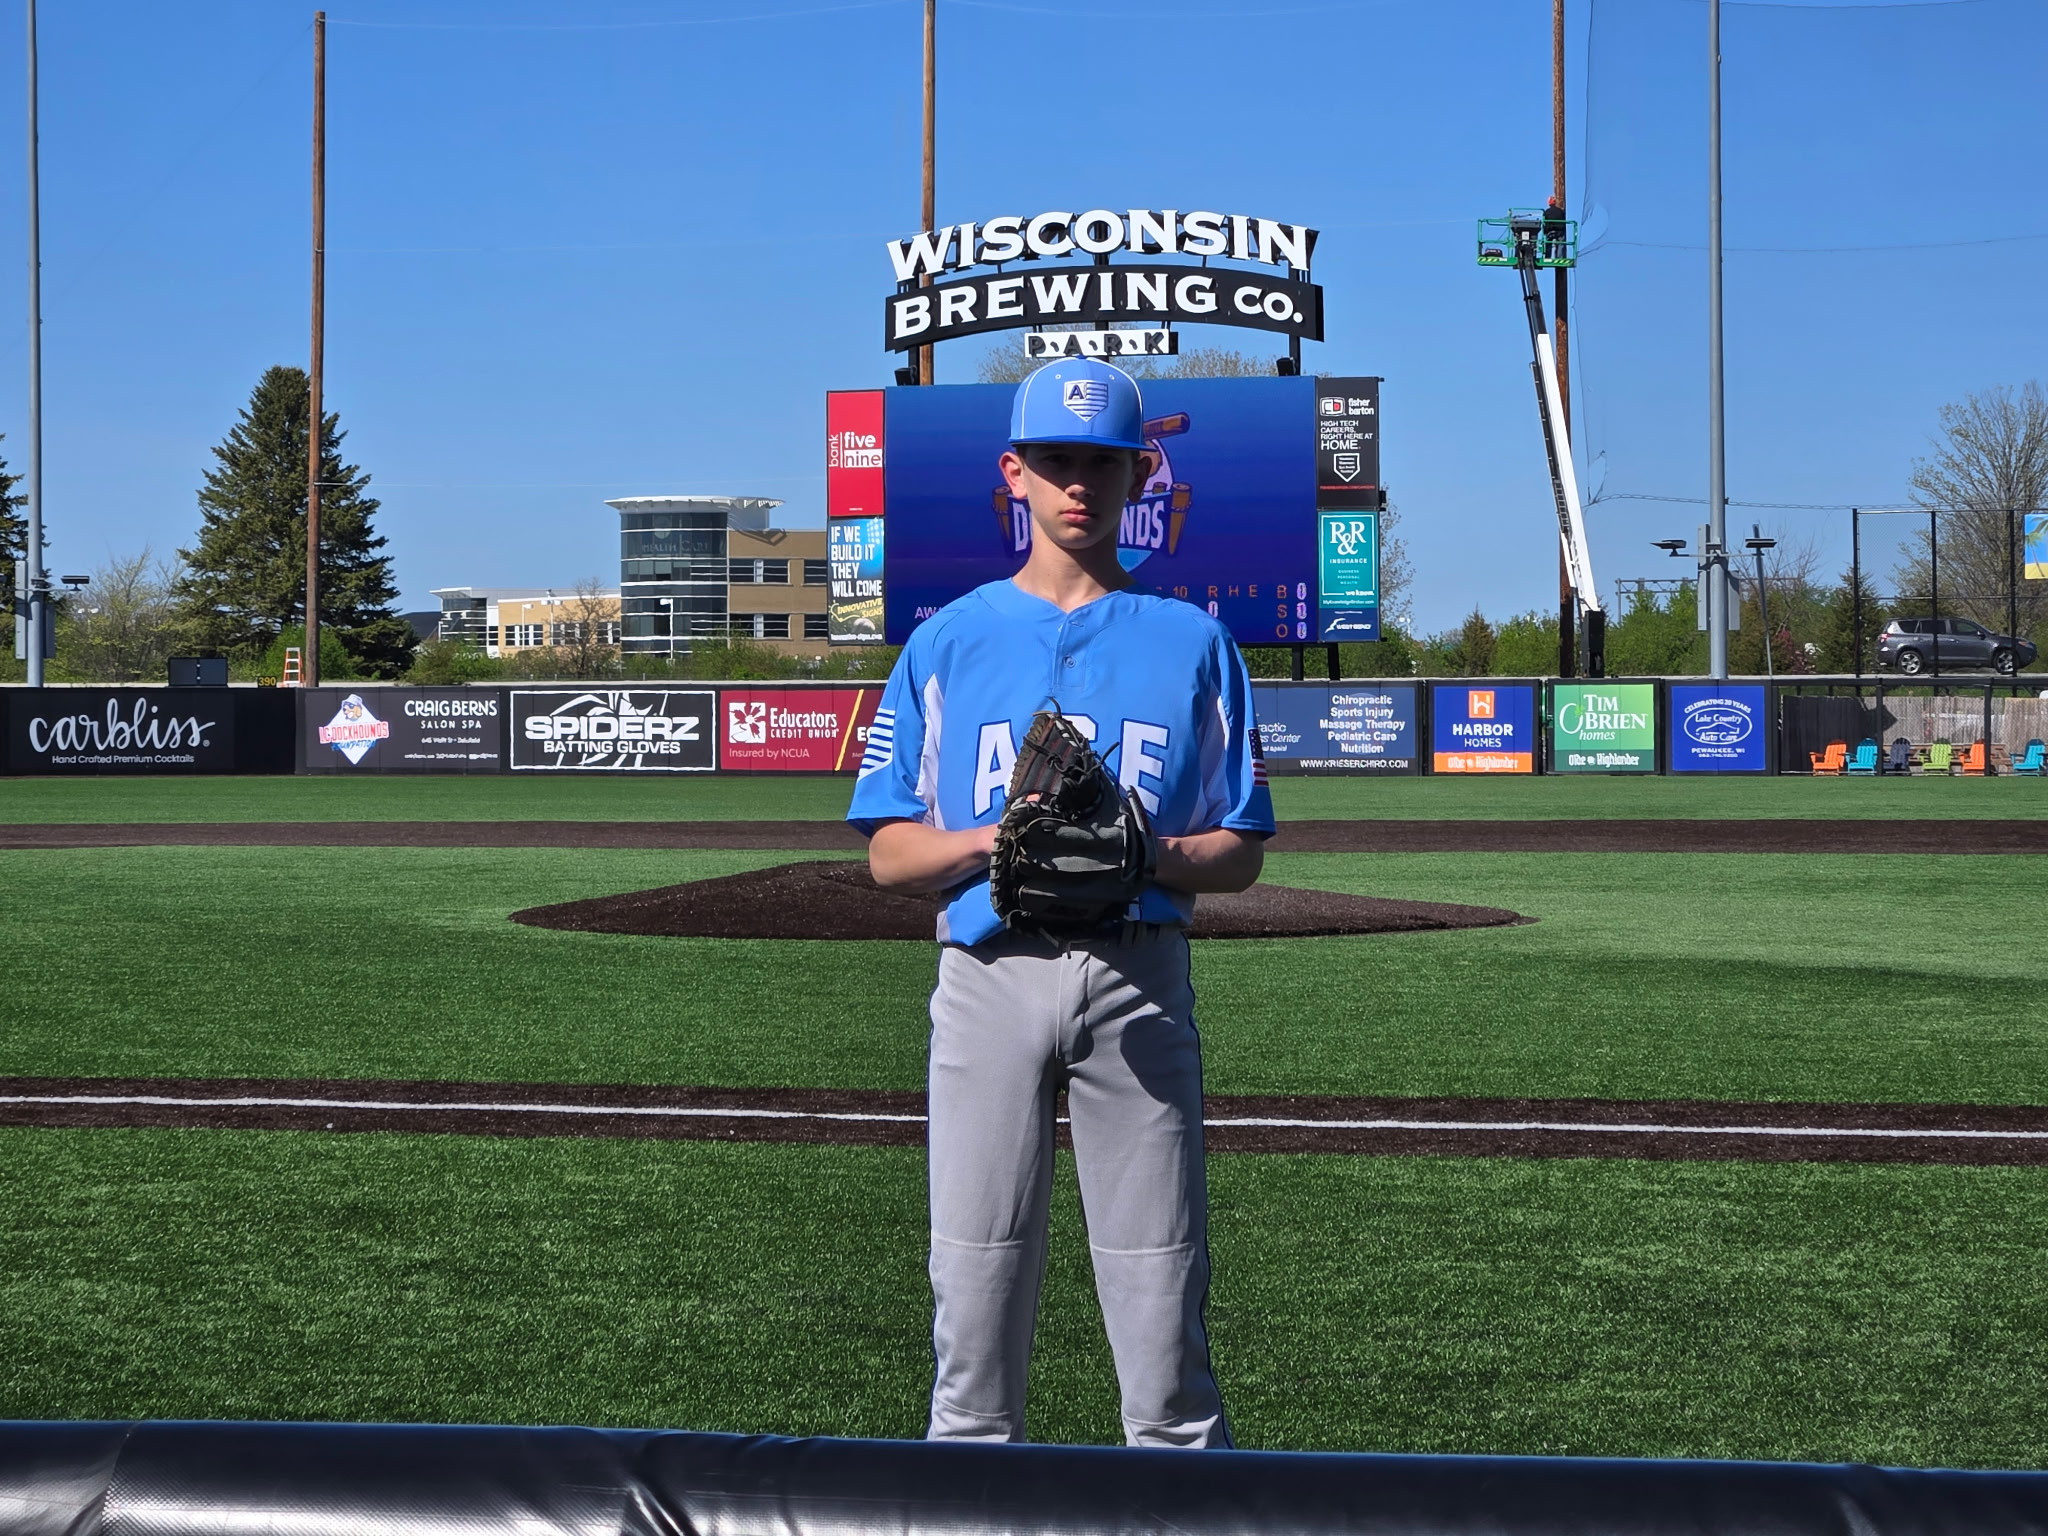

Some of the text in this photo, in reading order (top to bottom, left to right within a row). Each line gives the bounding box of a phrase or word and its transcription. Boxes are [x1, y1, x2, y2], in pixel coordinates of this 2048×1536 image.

[886, 209, 1310, 282] WISCONSIN
[893, 272, 1219, 339] BREWING
[1068, 384, 1085, 400] A
[1348, 398, 1370, 407] fisher
[1348, 407, 1374, 415] barton
[844, 431, 876, 448] five
[828, 434, 839, 467] bank
[845, 451, 882, 467] nine
[831, 526, 861, 543] IF WE
[831, 544, 875, 561] BUILD IT
[831, 562, 860, 579] THEY
[832, 580, 882, 597] WILL COME
[1208, 585, 1218, 597] R
[1229, 585, 1239, 597] H
[1249, 585, 1258, 597] E
[1276, 585, 1287, 599] B
[837, 597, 883, 614] INNOVATIVE
[1276, 604, 1288, 619] S
[258, 676, 277, 687] 390
[1332, 694, 1393, 706] Chiropractic
[1583, 694, 1618, 711] TIM
[770, 708, 838, 728] Educators
[1330, 706, 1394, 719] Sports Injury
[1695, 713, 1743, 725] Lake Country
[29, 697, 216, 753] carbliss
[421, 720, 482, 729] SALON SPA
[525, 715, 700, 741] SPIDERZ
[1319, 719, 1406, 731] Massage Therapy
[1452, 723, 1514, 736] HARBOR
[770, 729, 802, 739] CREDIT
[1271, 733, 1302, 743] Center
[1327, 731, 1398, 741] Pediatric Care
[1579, 729, 1616, 740] homes
[1700, 732, 1718, 741] Auto
[543, 741, 681, 754] BATTING GLOVES
[1341, 743, 1384, 753] Nutrition
[1464, 738, 1502, 748] HOMES
[52, 753, 195, 764] Hand Crafted Premium Cocktails
[729, 748, 810, 760] Insured by NCUA
